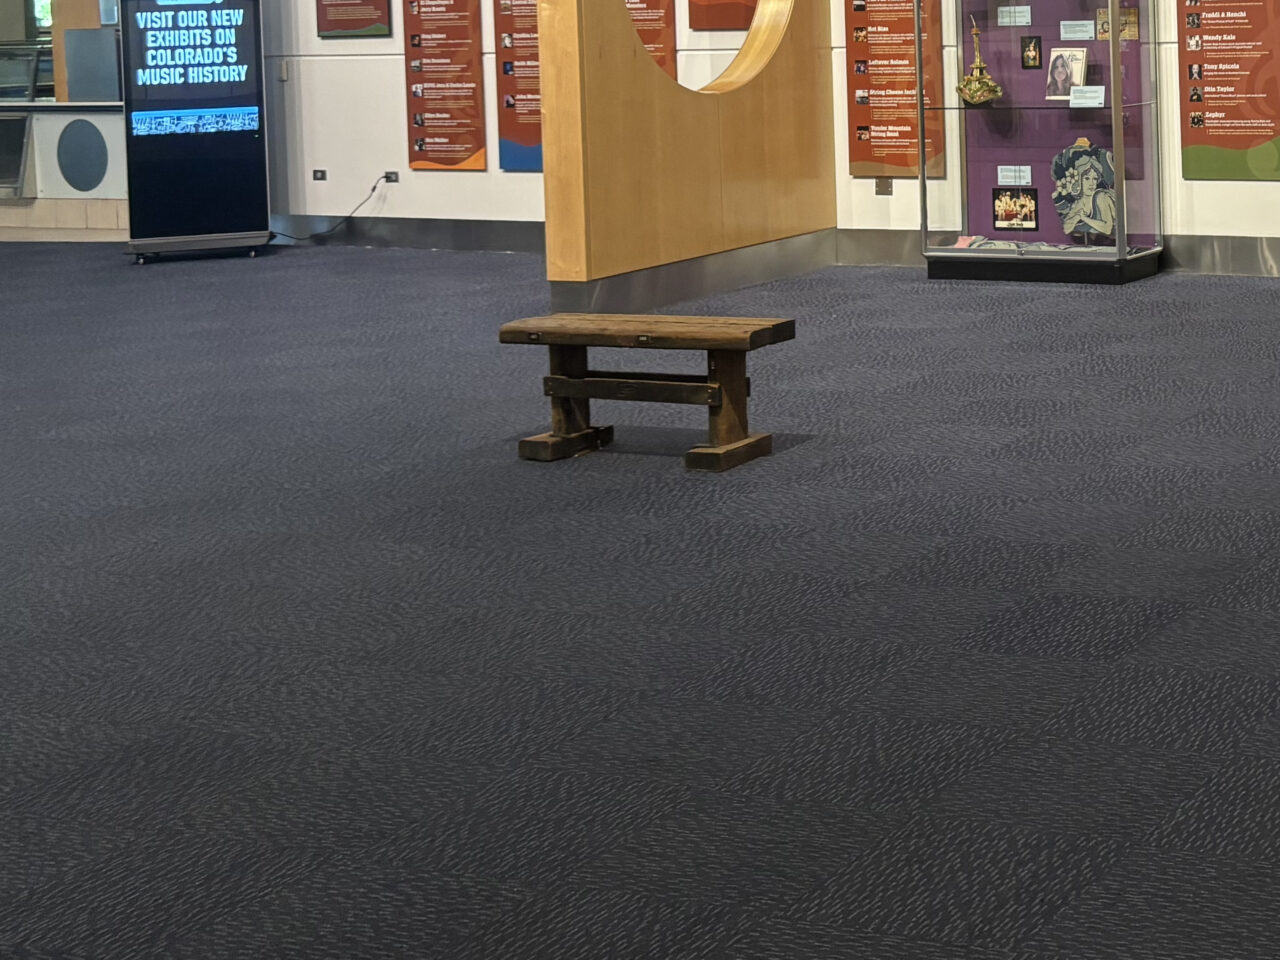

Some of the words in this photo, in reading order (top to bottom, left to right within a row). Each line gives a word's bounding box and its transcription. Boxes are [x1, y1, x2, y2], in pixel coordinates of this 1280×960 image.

[136, 11, 174, 28] VISIT
[178, 10, 207, 27] OUR
[211, 9, 243, 26] NEW
[146, 30, 212, 47] EXHIBITS
[215, 28, 235, 44] ON
[147, 47, 237, 66] COLORADO'S
[137, 67, 184, 85] MUSIC
[188, 65, 248, 84] HISTORY
